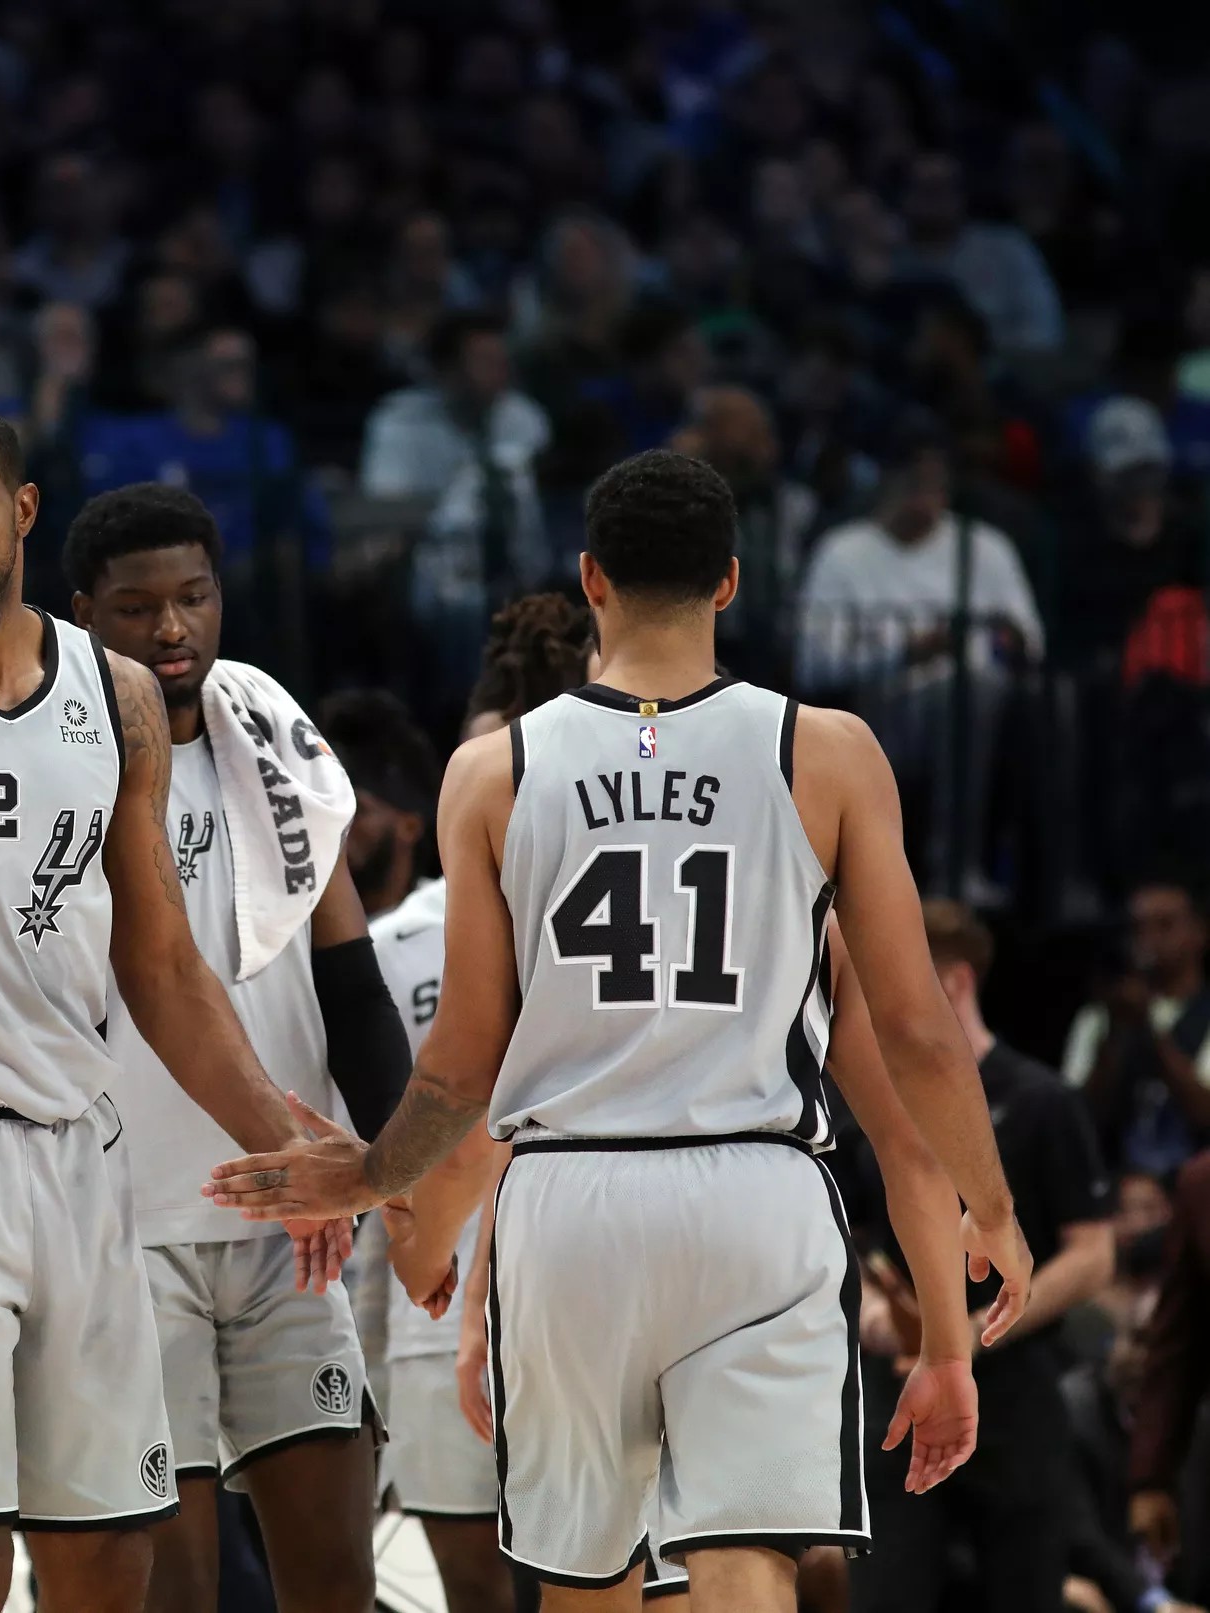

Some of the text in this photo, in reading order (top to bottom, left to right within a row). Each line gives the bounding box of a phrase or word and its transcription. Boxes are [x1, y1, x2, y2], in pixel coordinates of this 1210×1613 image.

[59, 725, 102, 744] Frost
[575, 770, 721, 830] LYLES
[544, 843, 746, 1012] 41
